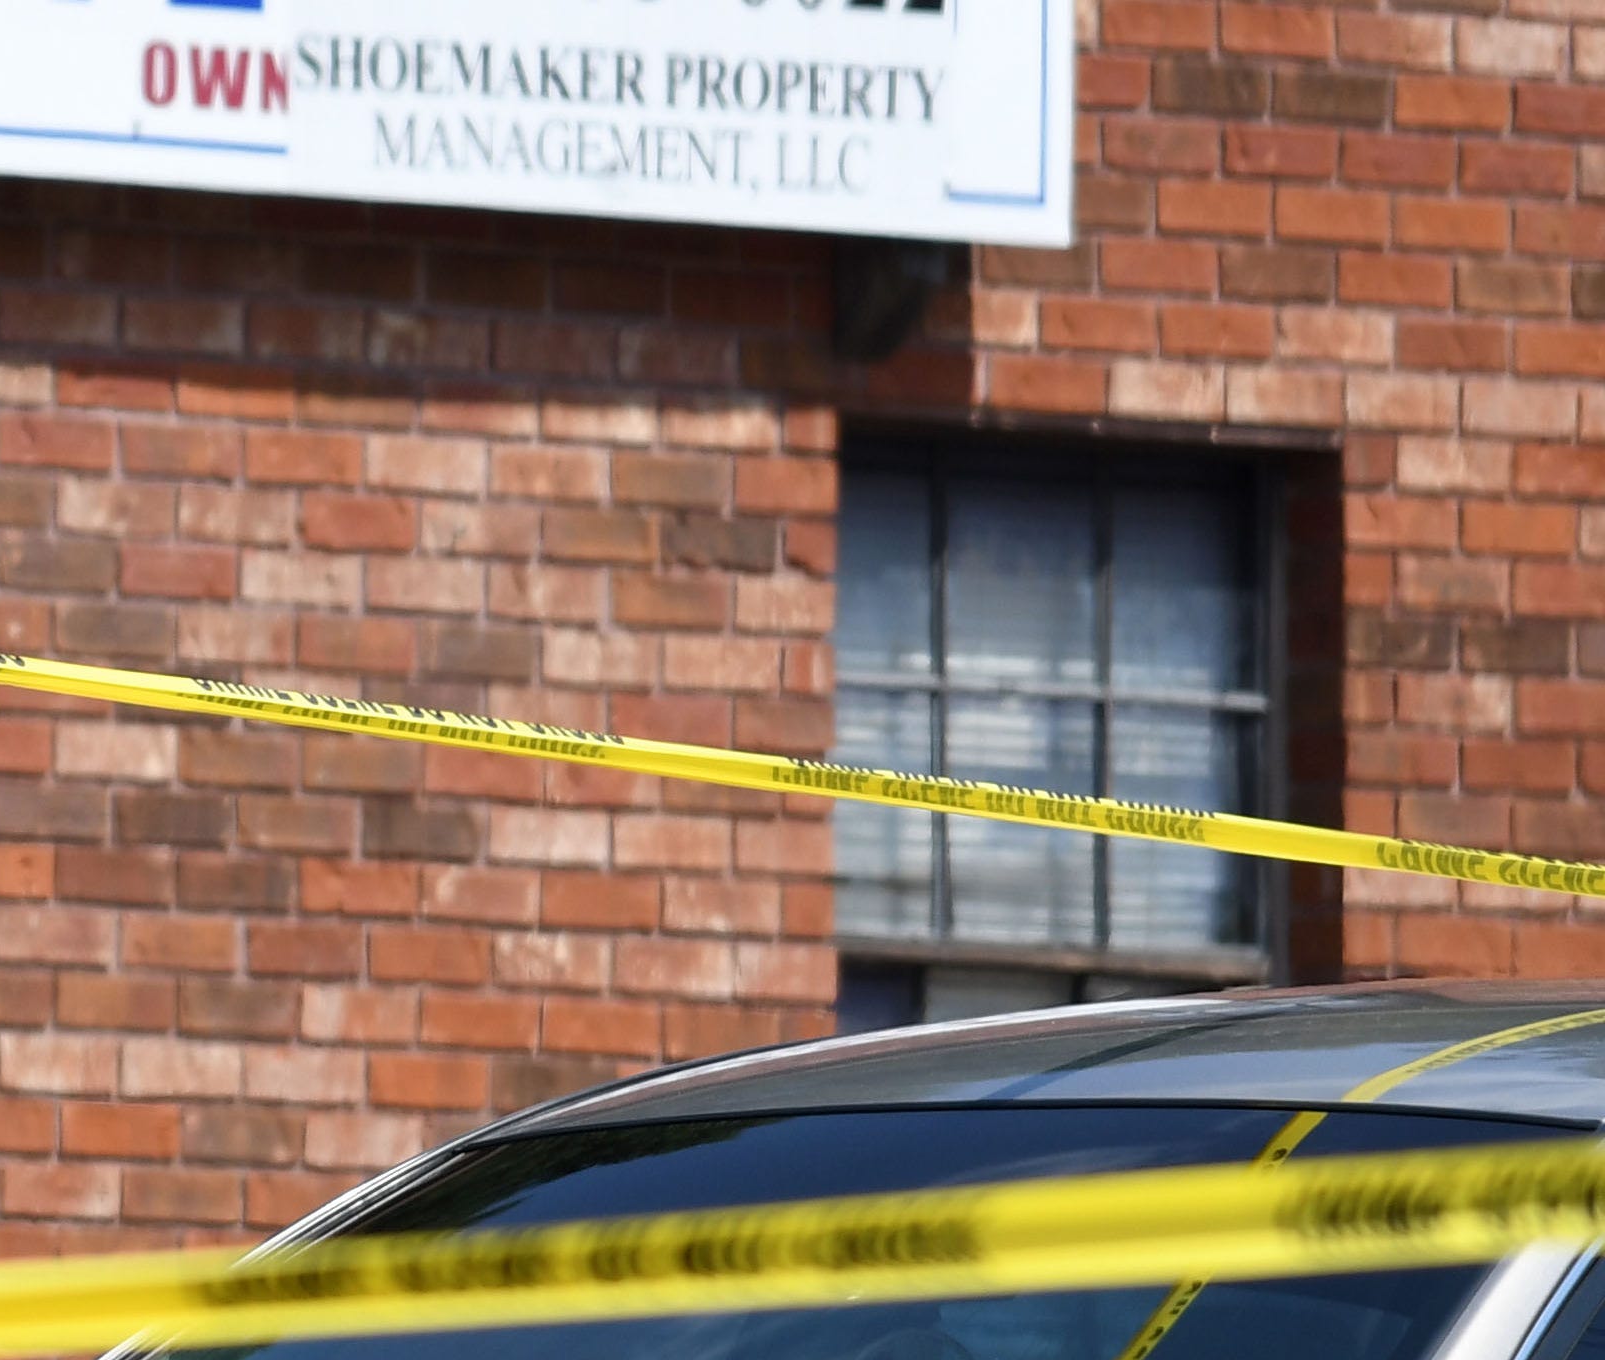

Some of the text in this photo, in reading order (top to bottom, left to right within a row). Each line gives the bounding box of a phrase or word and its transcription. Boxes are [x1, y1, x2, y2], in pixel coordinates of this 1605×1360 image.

[296, 34, 944, 121] SHOEMAKER PROPERTY
[777, 131, 871, 193] LLC
